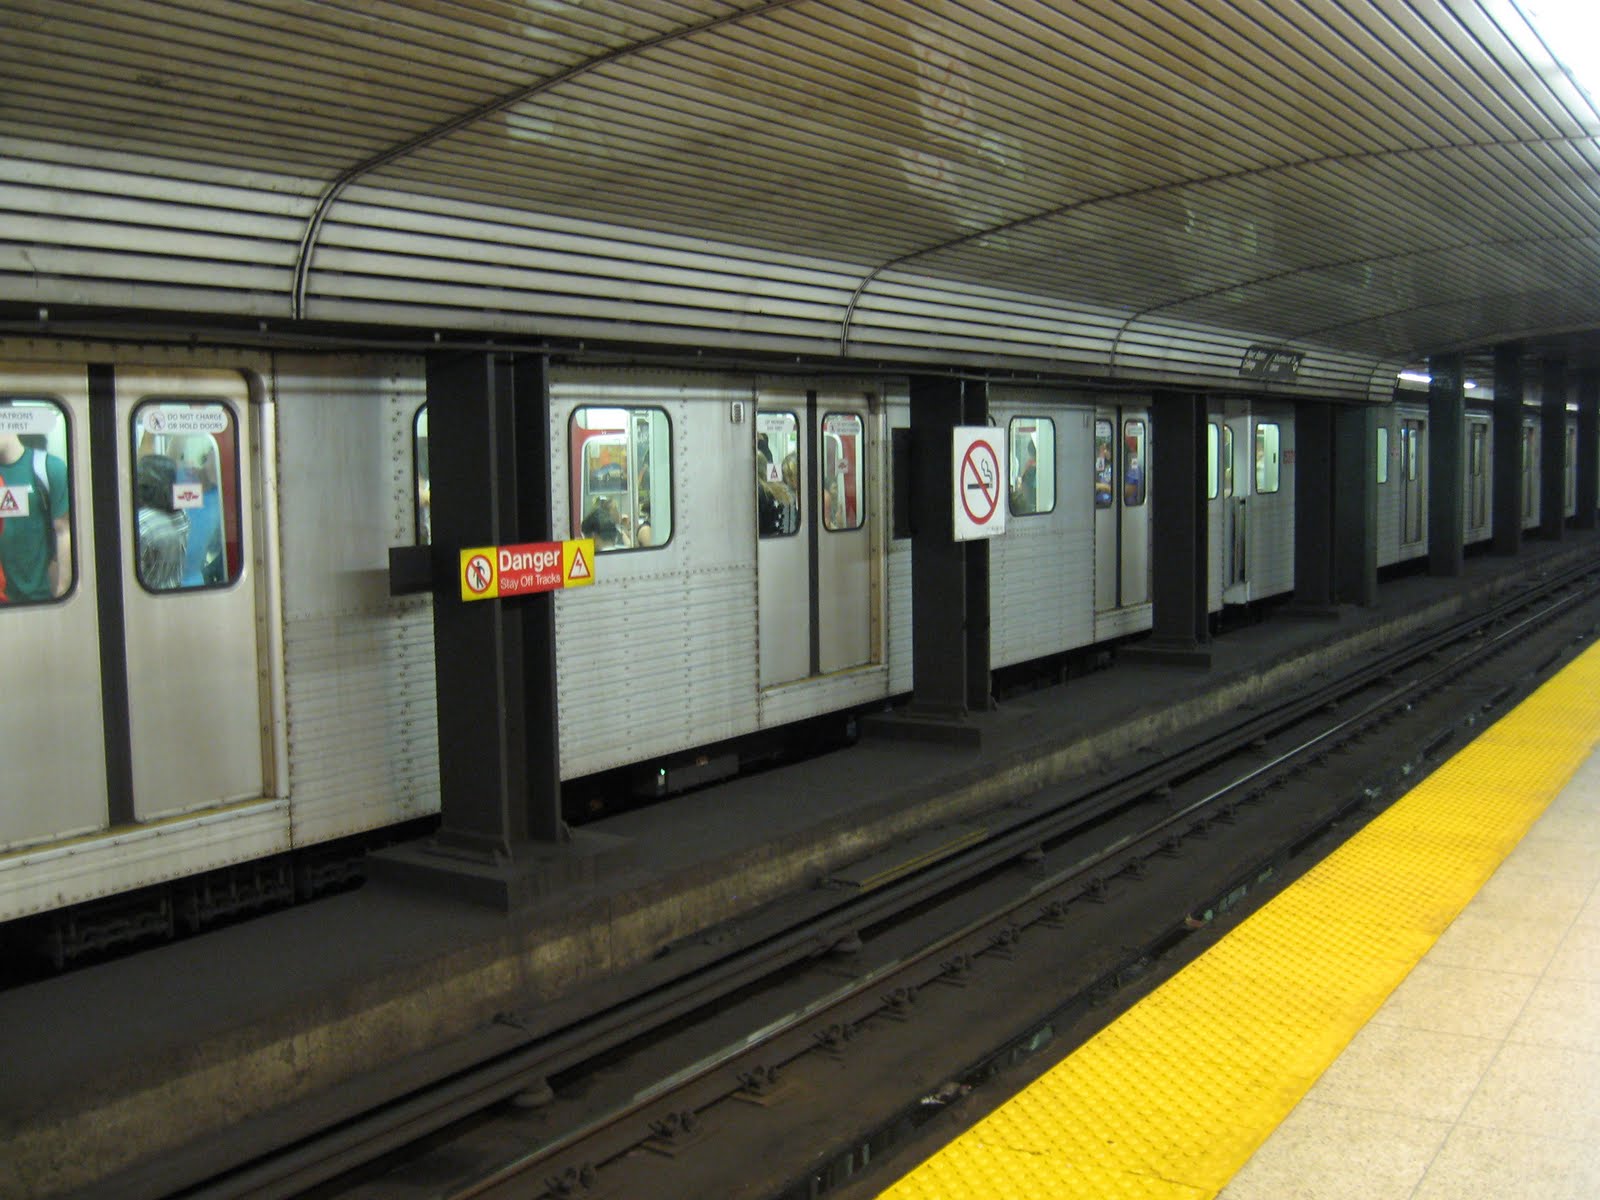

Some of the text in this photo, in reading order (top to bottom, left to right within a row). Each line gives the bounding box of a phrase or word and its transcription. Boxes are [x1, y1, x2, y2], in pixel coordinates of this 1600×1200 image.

[168, 413, 223, 421] DO NOT CHARGE
[8, 422, 28, 430] FIRST
[168, 422, 223, 430] OR HOLD DOORS
[499, 550, 561, 572] Danger
[500, 573, 561, 591] Stay Off Tracks
